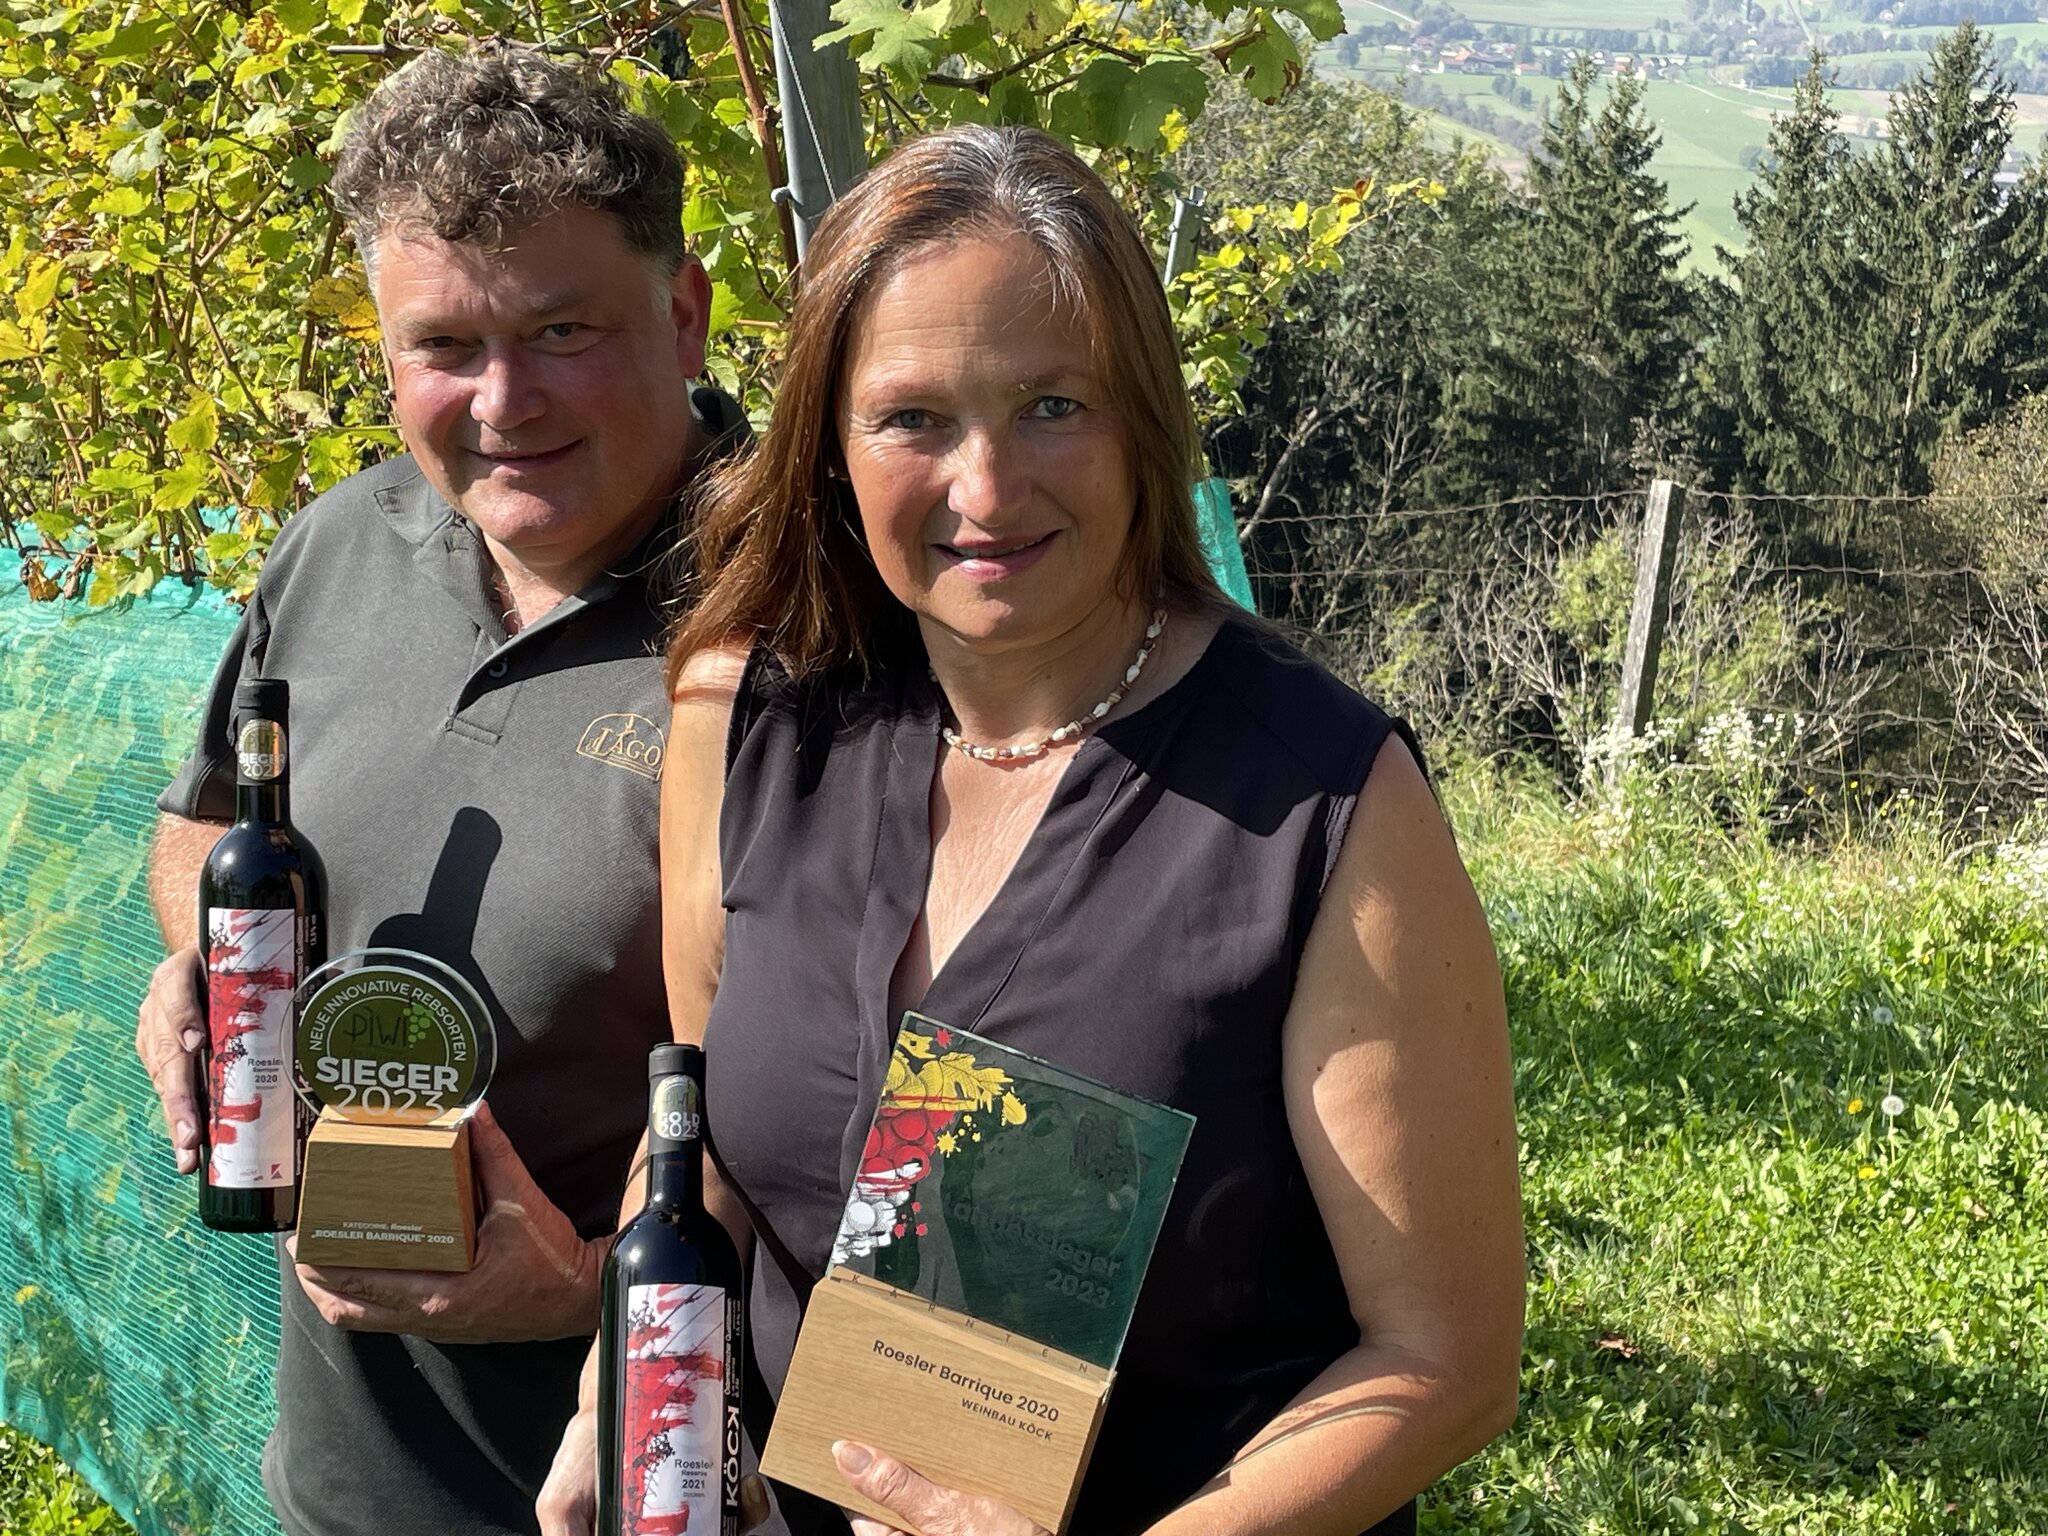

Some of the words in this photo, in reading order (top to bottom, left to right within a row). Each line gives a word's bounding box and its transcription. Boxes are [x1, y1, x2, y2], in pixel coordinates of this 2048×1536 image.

[242, 763, 280, 778] 202
[310, 1011, 331, 1052] NEUE
[324, 980, 410, 1014] INNOVATIVE
[411, 987, 467, 1062] REBSORTEN
[255, 1075, 278, 1083] 2020
[315, 1056, 460, 1093] SIEGER
[333, 1084, 446, 1119] 2023
[427, 1234, 455, 1244] 2020
[873, 1339, 937, 1375] Roesler
[939, 1365, 1013, 1404] Barrique
[1016, 1395, 1060, 1422] 2020
[962, 1397, 1017, 1426] WEINBAU
[1019, 1420, 1053, 1441] KÖCK
[723, 1405, 740, 1507] KÖCK
[682, 1479, 705, 1489] 2021
